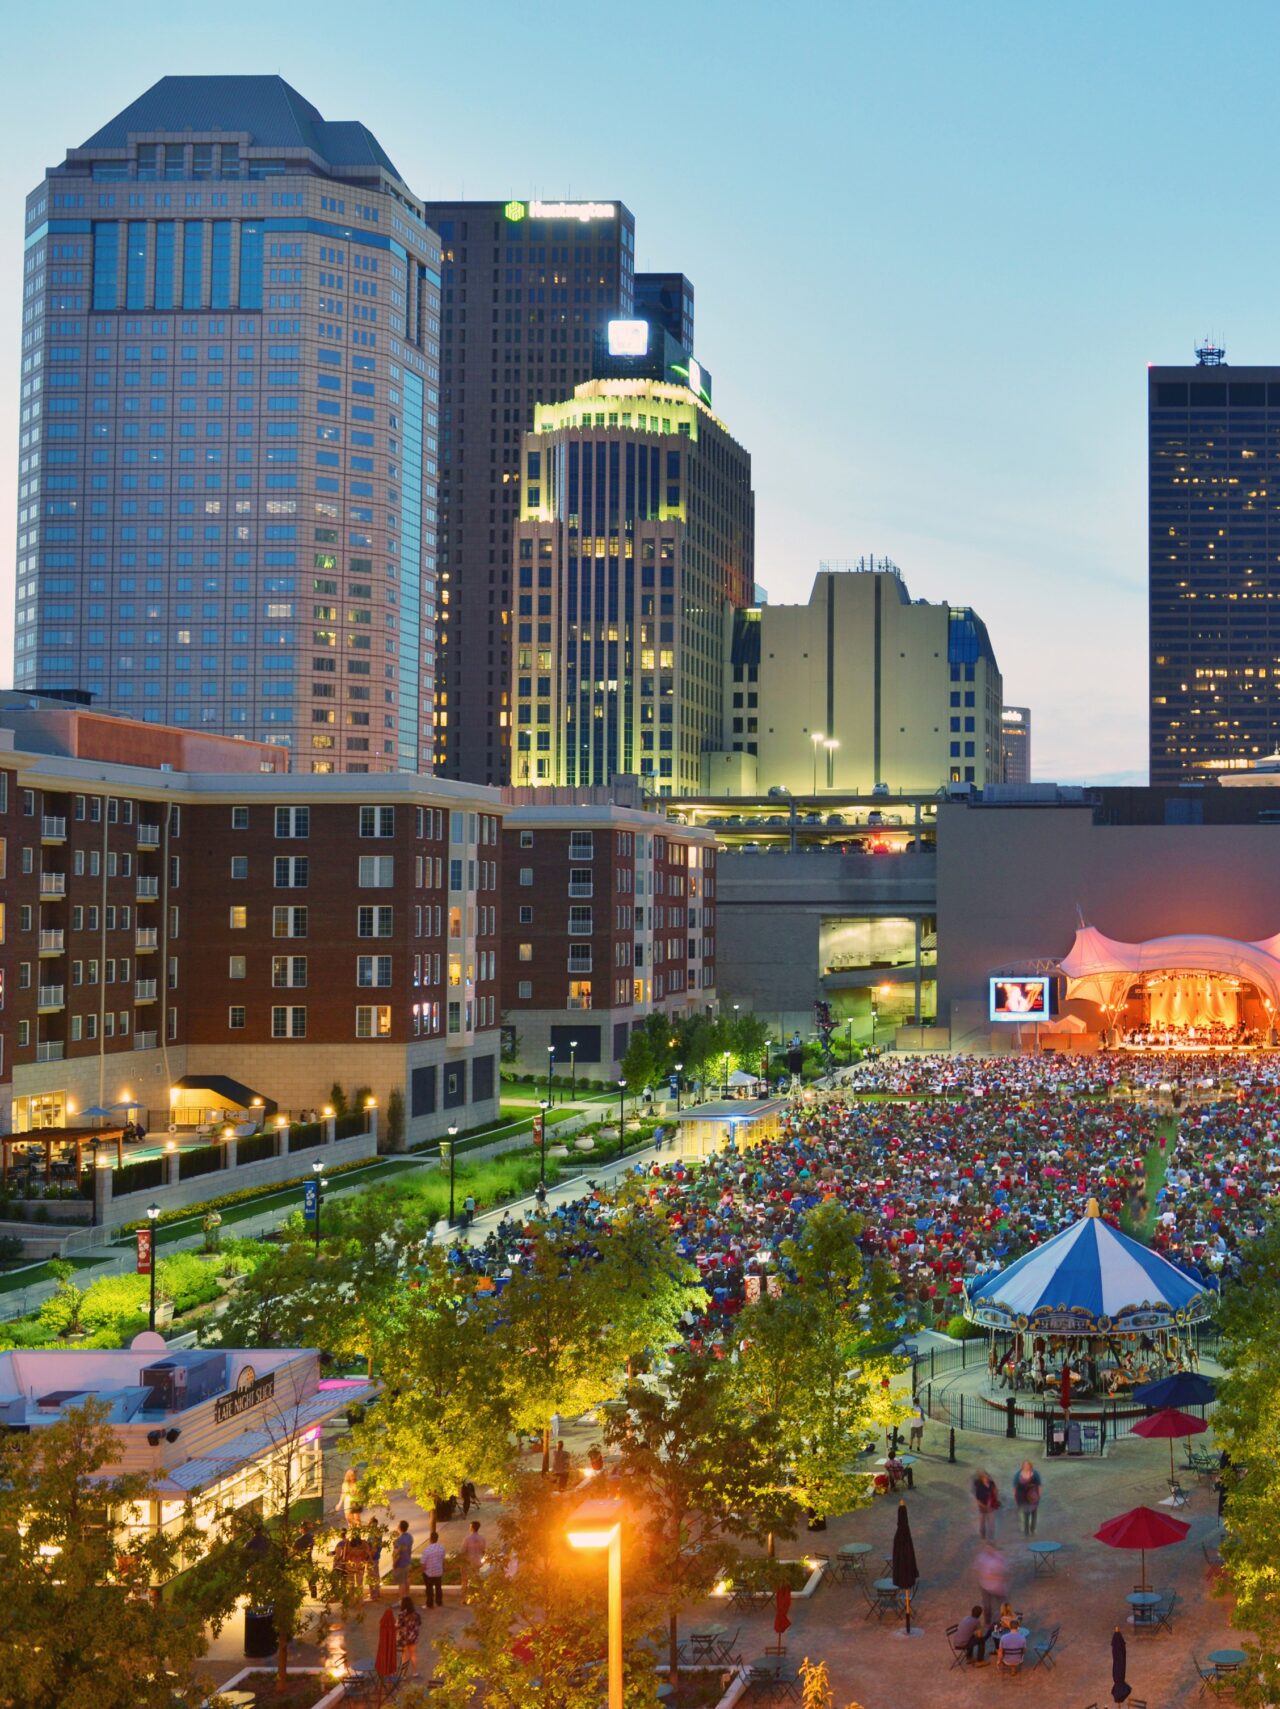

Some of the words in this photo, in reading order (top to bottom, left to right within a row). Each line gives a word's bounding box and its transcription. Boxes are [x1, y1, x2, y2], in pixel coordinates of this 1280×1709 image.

[217, 1401, 233, 1422] LATE
[234, 1390, 255, 1412] NIGHT
[255, 1381, 273, 1403] SLICE
